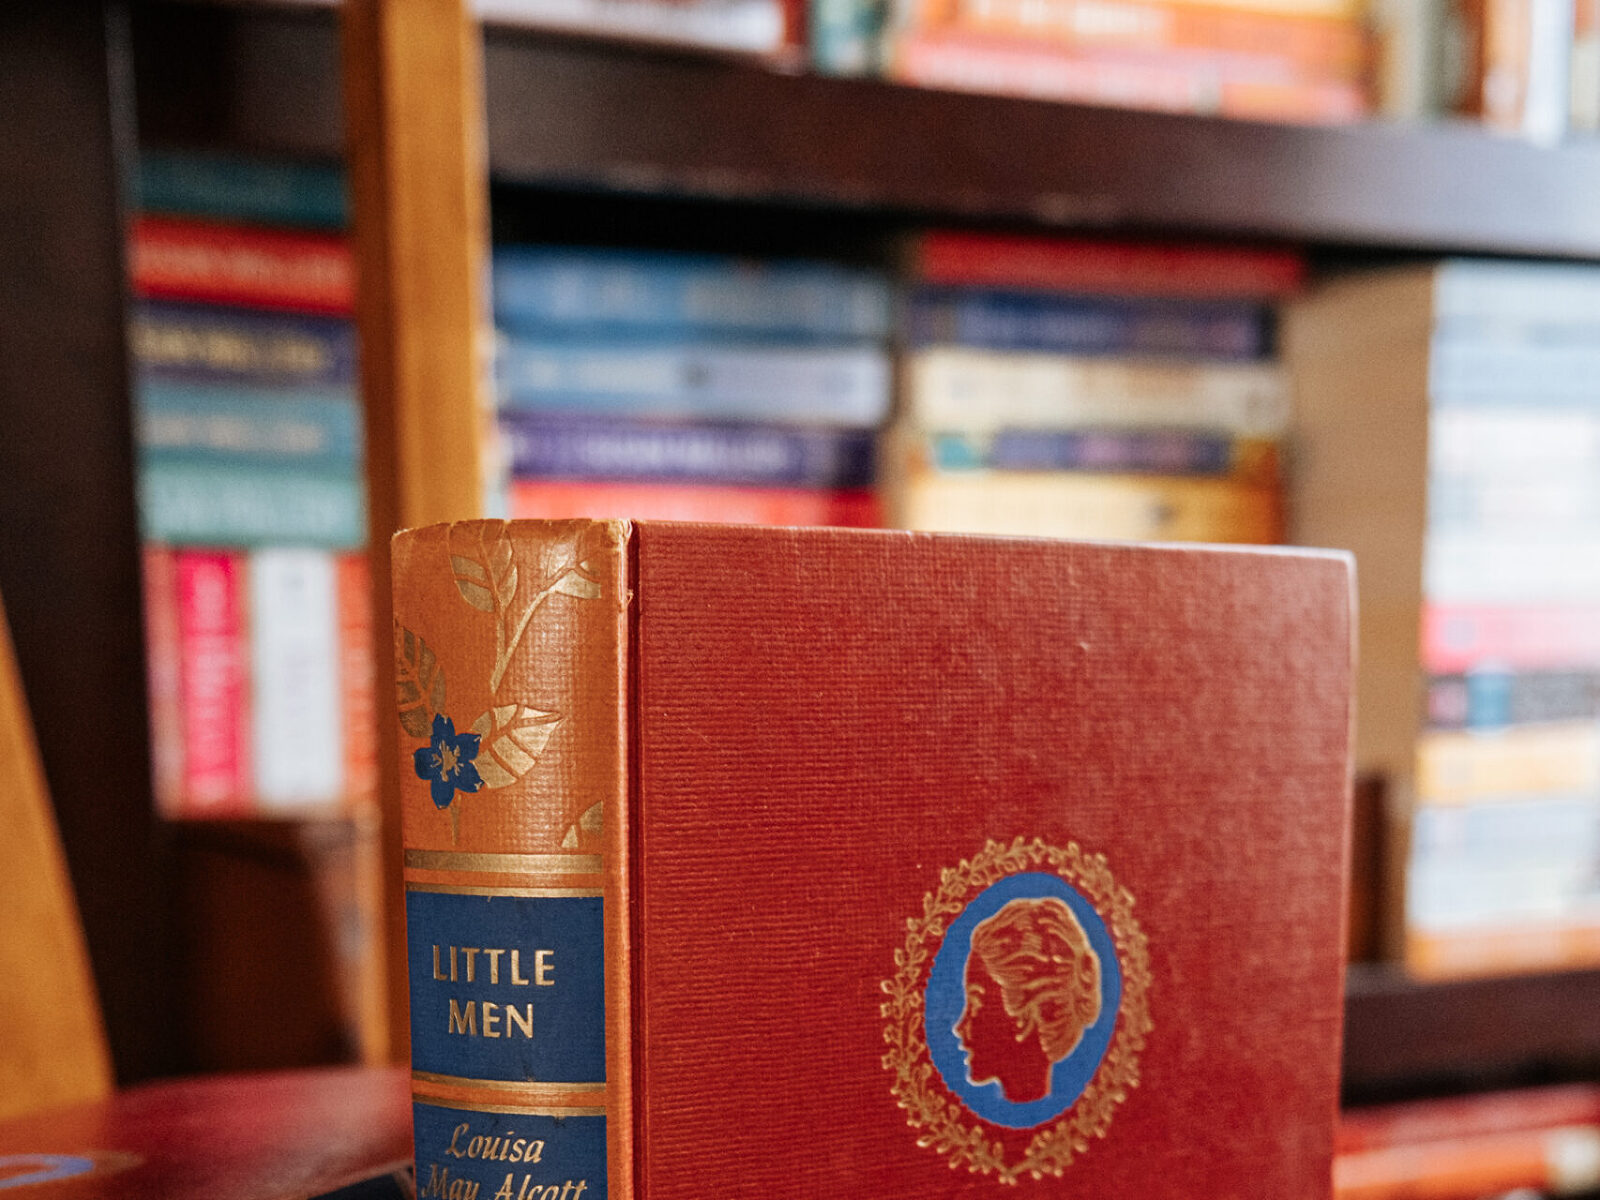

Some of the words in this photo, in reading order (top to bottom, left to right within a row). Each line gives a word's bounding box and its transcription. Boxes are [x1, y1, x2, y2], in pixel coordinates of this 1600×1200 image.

[432, 944, 555, 985] LITTLE
[448, 1000, 534, 1038] MEN
[445, 1123, 545, 1163] Louisa
